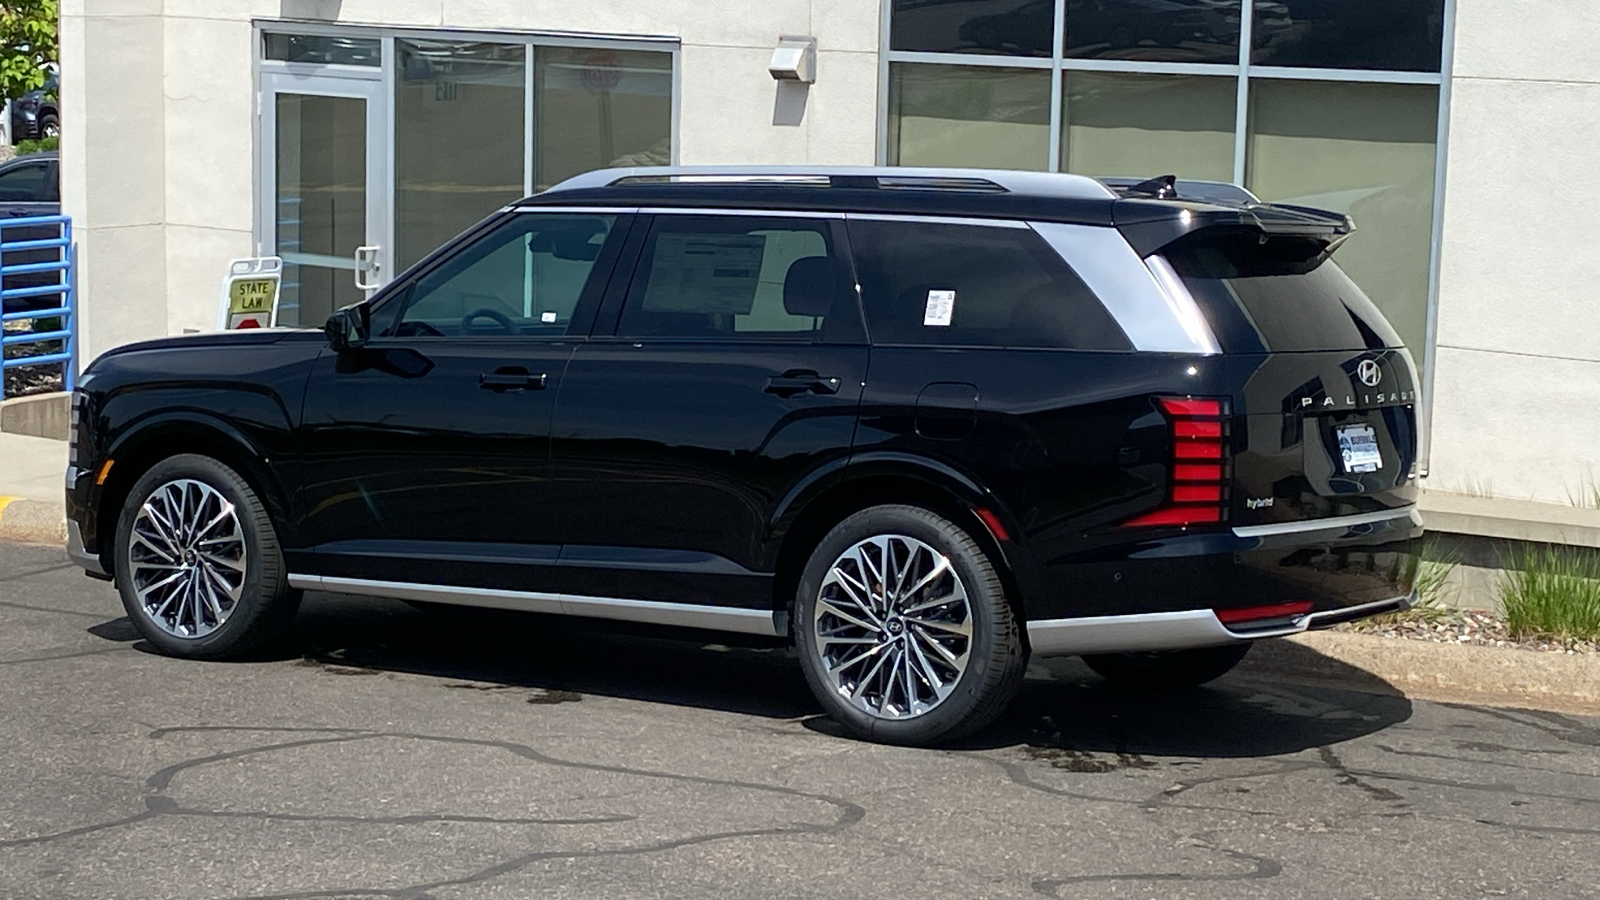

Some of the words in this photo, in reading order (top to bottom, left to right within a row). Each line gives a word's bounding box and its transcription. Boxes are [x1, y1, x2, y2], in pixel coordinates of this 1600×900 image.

[239, 282, 269, 295] STATE
[242, 297, 263, 309] LAW
[1246, 497, 1274, 510] hybrid
